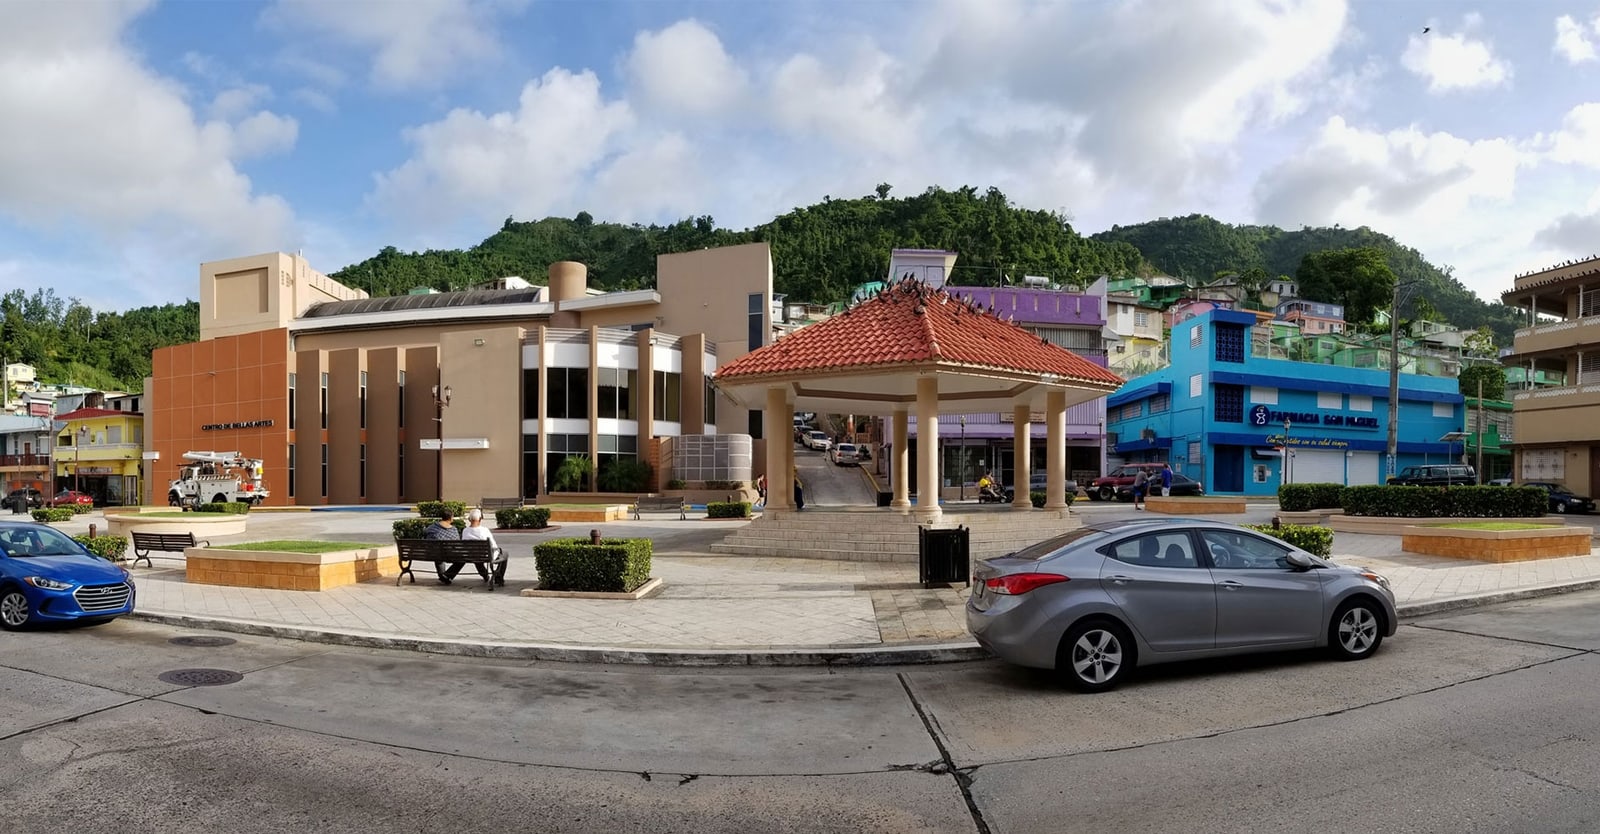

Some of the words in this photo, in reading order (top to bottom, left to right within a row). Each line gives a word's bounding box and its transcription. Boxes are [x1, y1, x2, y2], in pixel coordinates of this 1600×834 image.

[233, 421, 253, 429] BELLAS
[254, 419, 273, 427] ARTES
[1270, 411, 1320, 424] FARMACIA
[1345, 416, 1380, 428] MIGUEL
